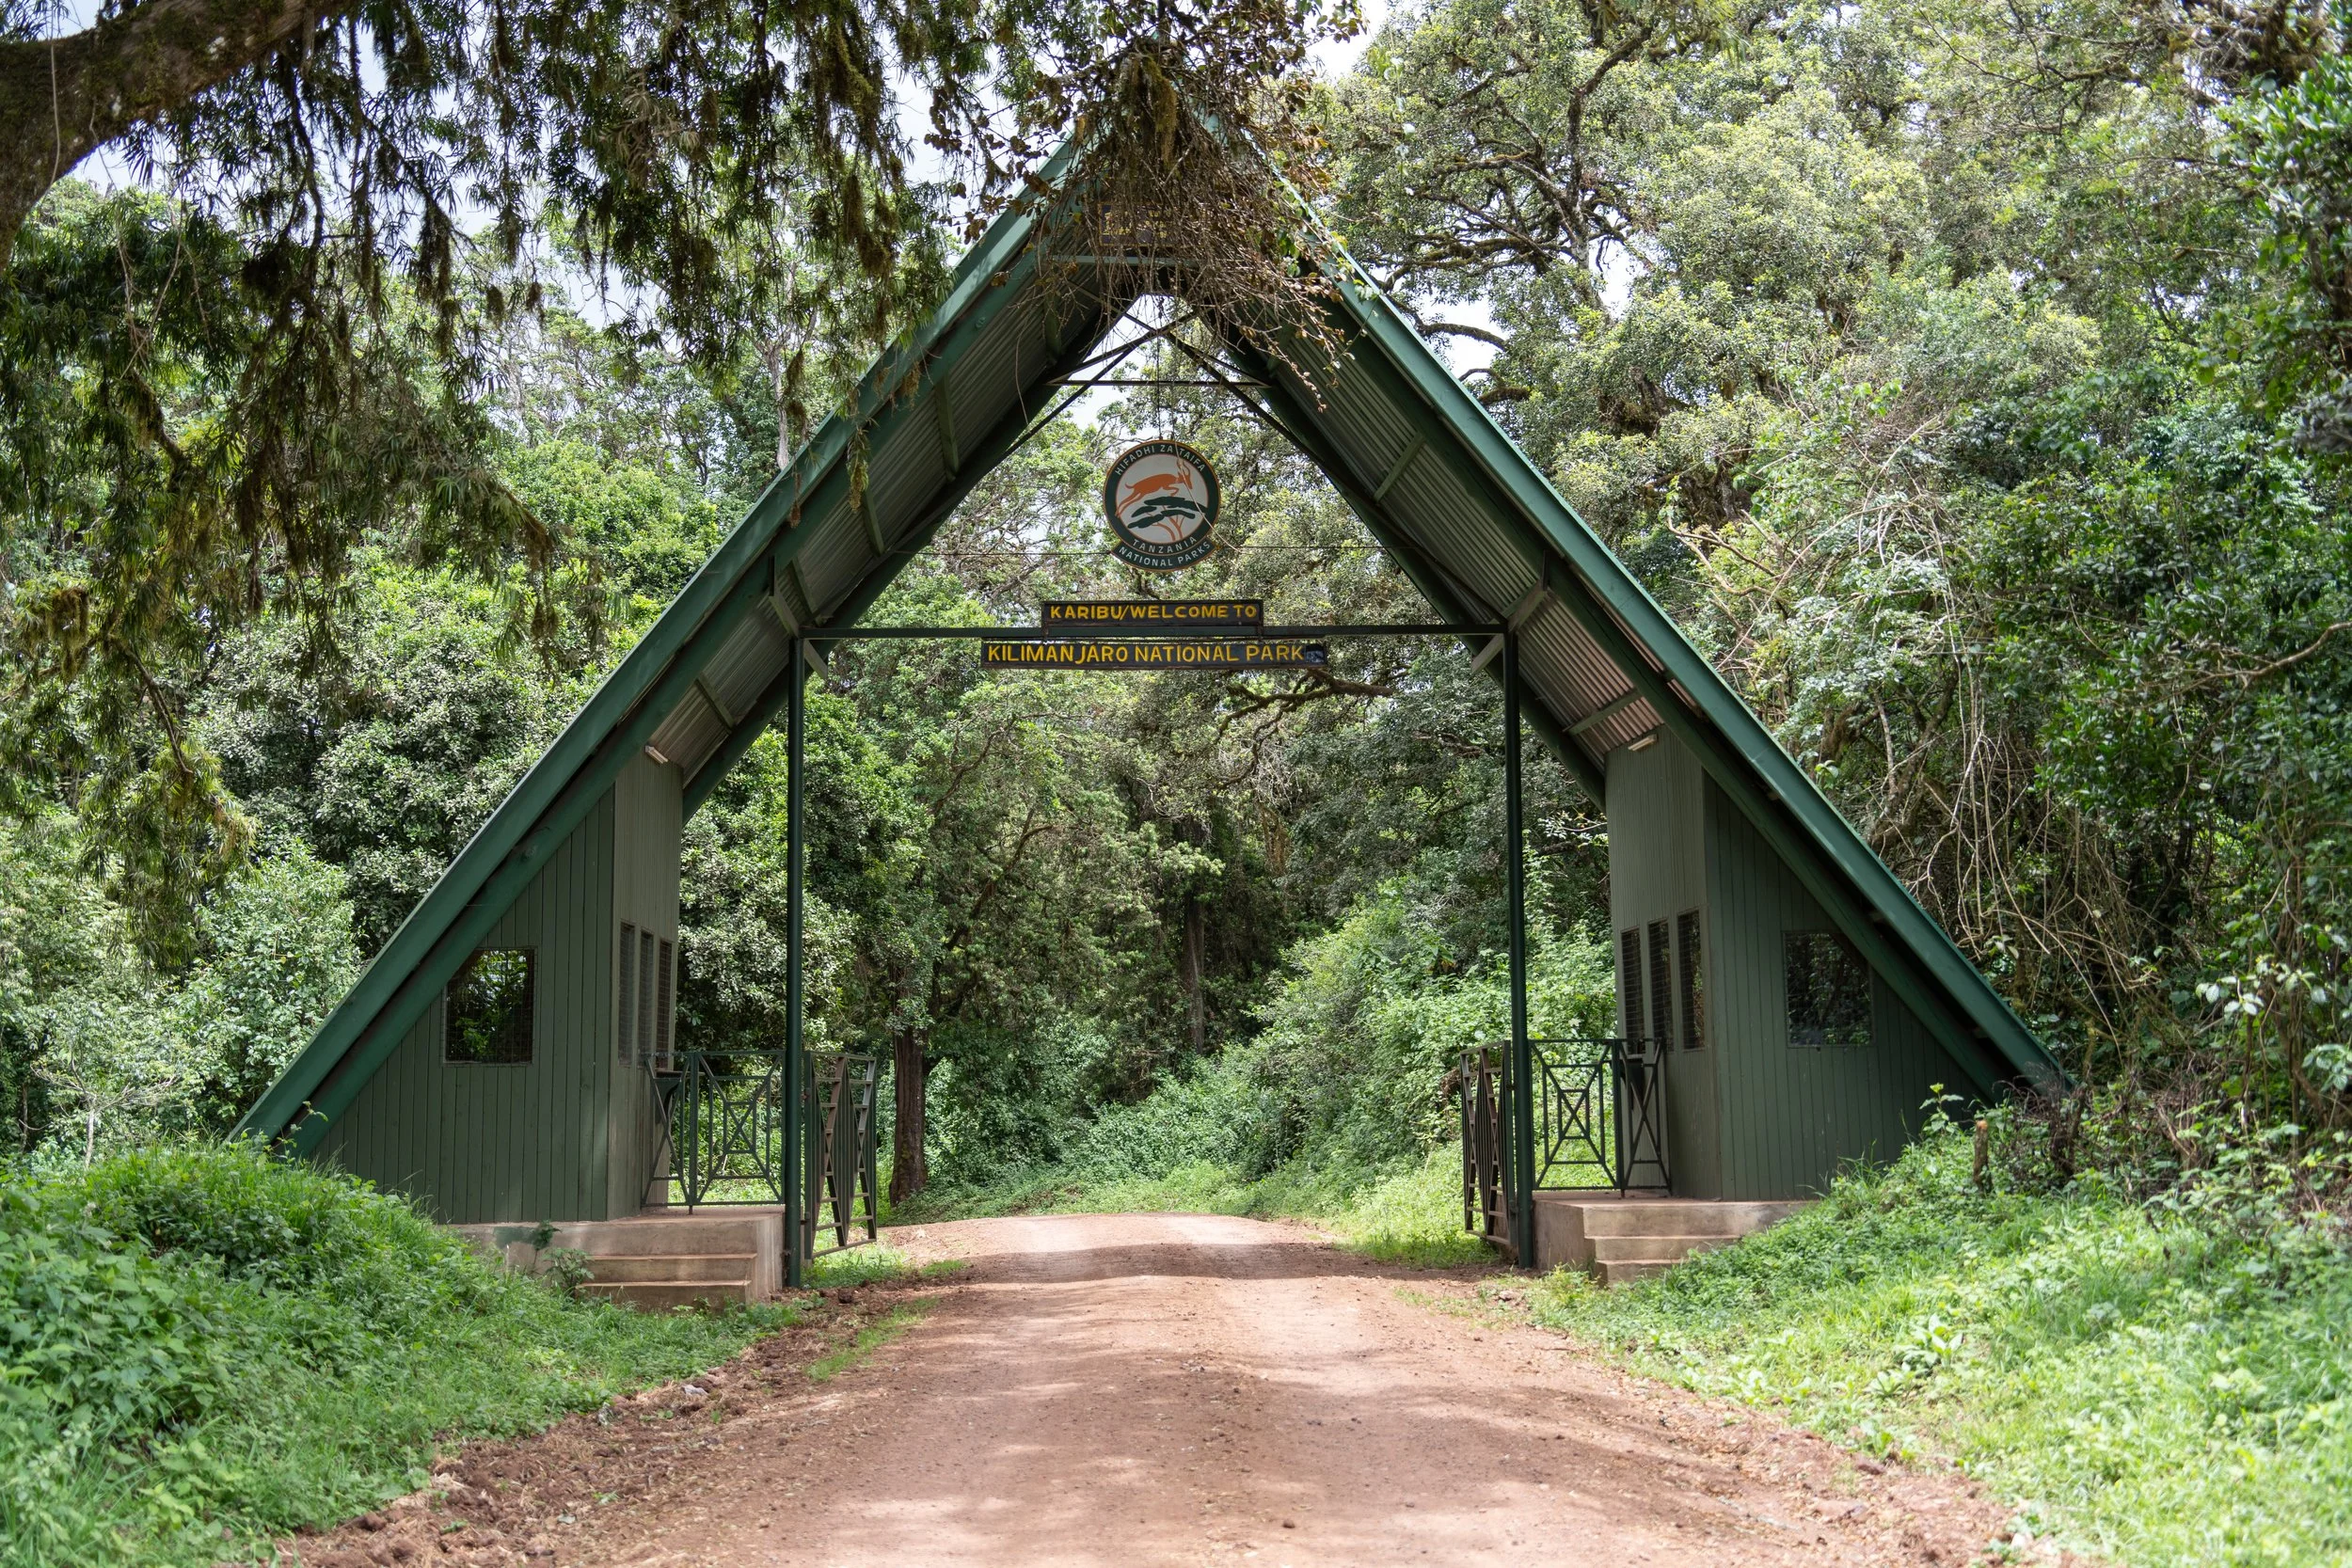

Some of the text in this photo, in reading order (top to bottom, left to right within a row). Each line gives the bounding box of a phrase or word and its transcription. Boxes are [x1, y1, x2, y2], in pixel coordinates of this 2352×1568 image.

[1115, 444, 1205, 476] HIFADHI ZA TAIFA
[1119, 541, 1211, 567] NATIONAL PARKS
[1133, 536, 1197, 554] TANZANIA
[1050, 605, 1257, 621] KARIBU/WELCOME TO
[988, 644, 1304, 665] KILIMANJARO NATIONAL PARK
